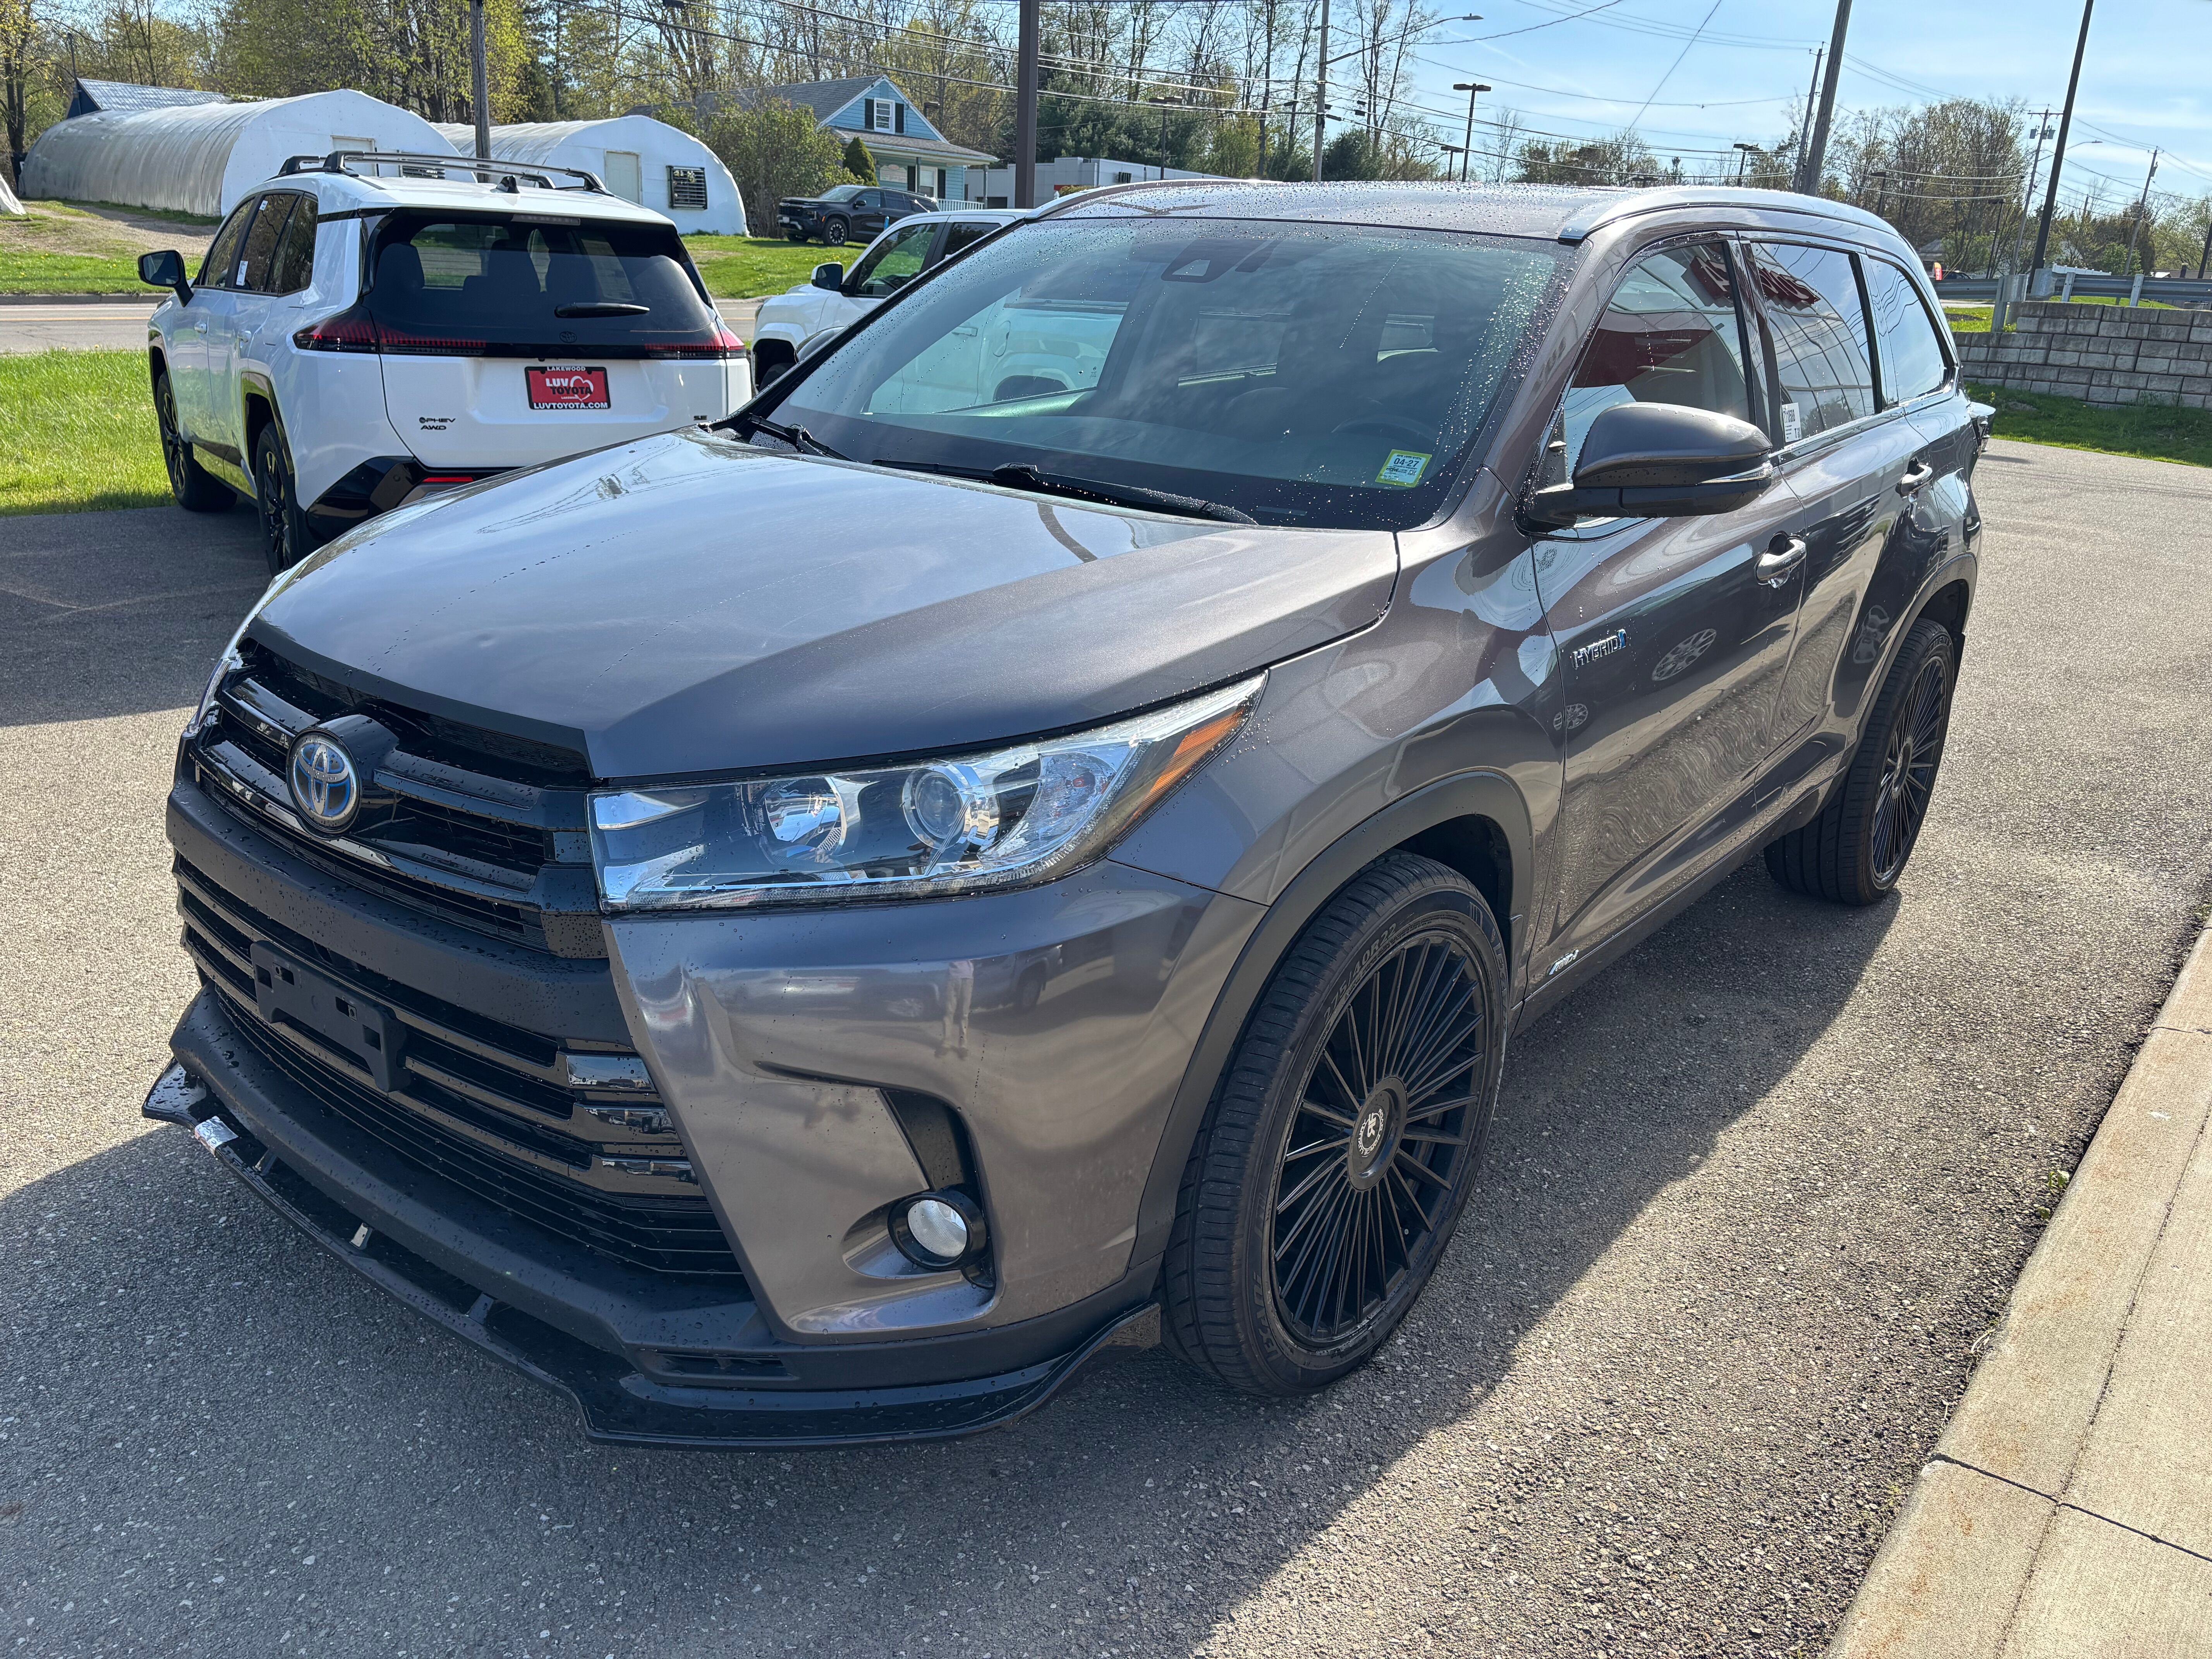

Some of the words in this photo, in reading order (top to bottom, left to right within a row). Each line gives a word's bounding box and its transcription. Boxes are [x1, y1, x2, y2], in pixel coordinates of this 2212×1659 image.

[546, 378, 568, 387] LUV
[550, 386, 593, 395] TOYOTA
[1394, 458, 1419, 467] 04-27
[1572, 635, 1621, 669] HYBRID
[1358, 1118, 1366, 1154] LUXURY
